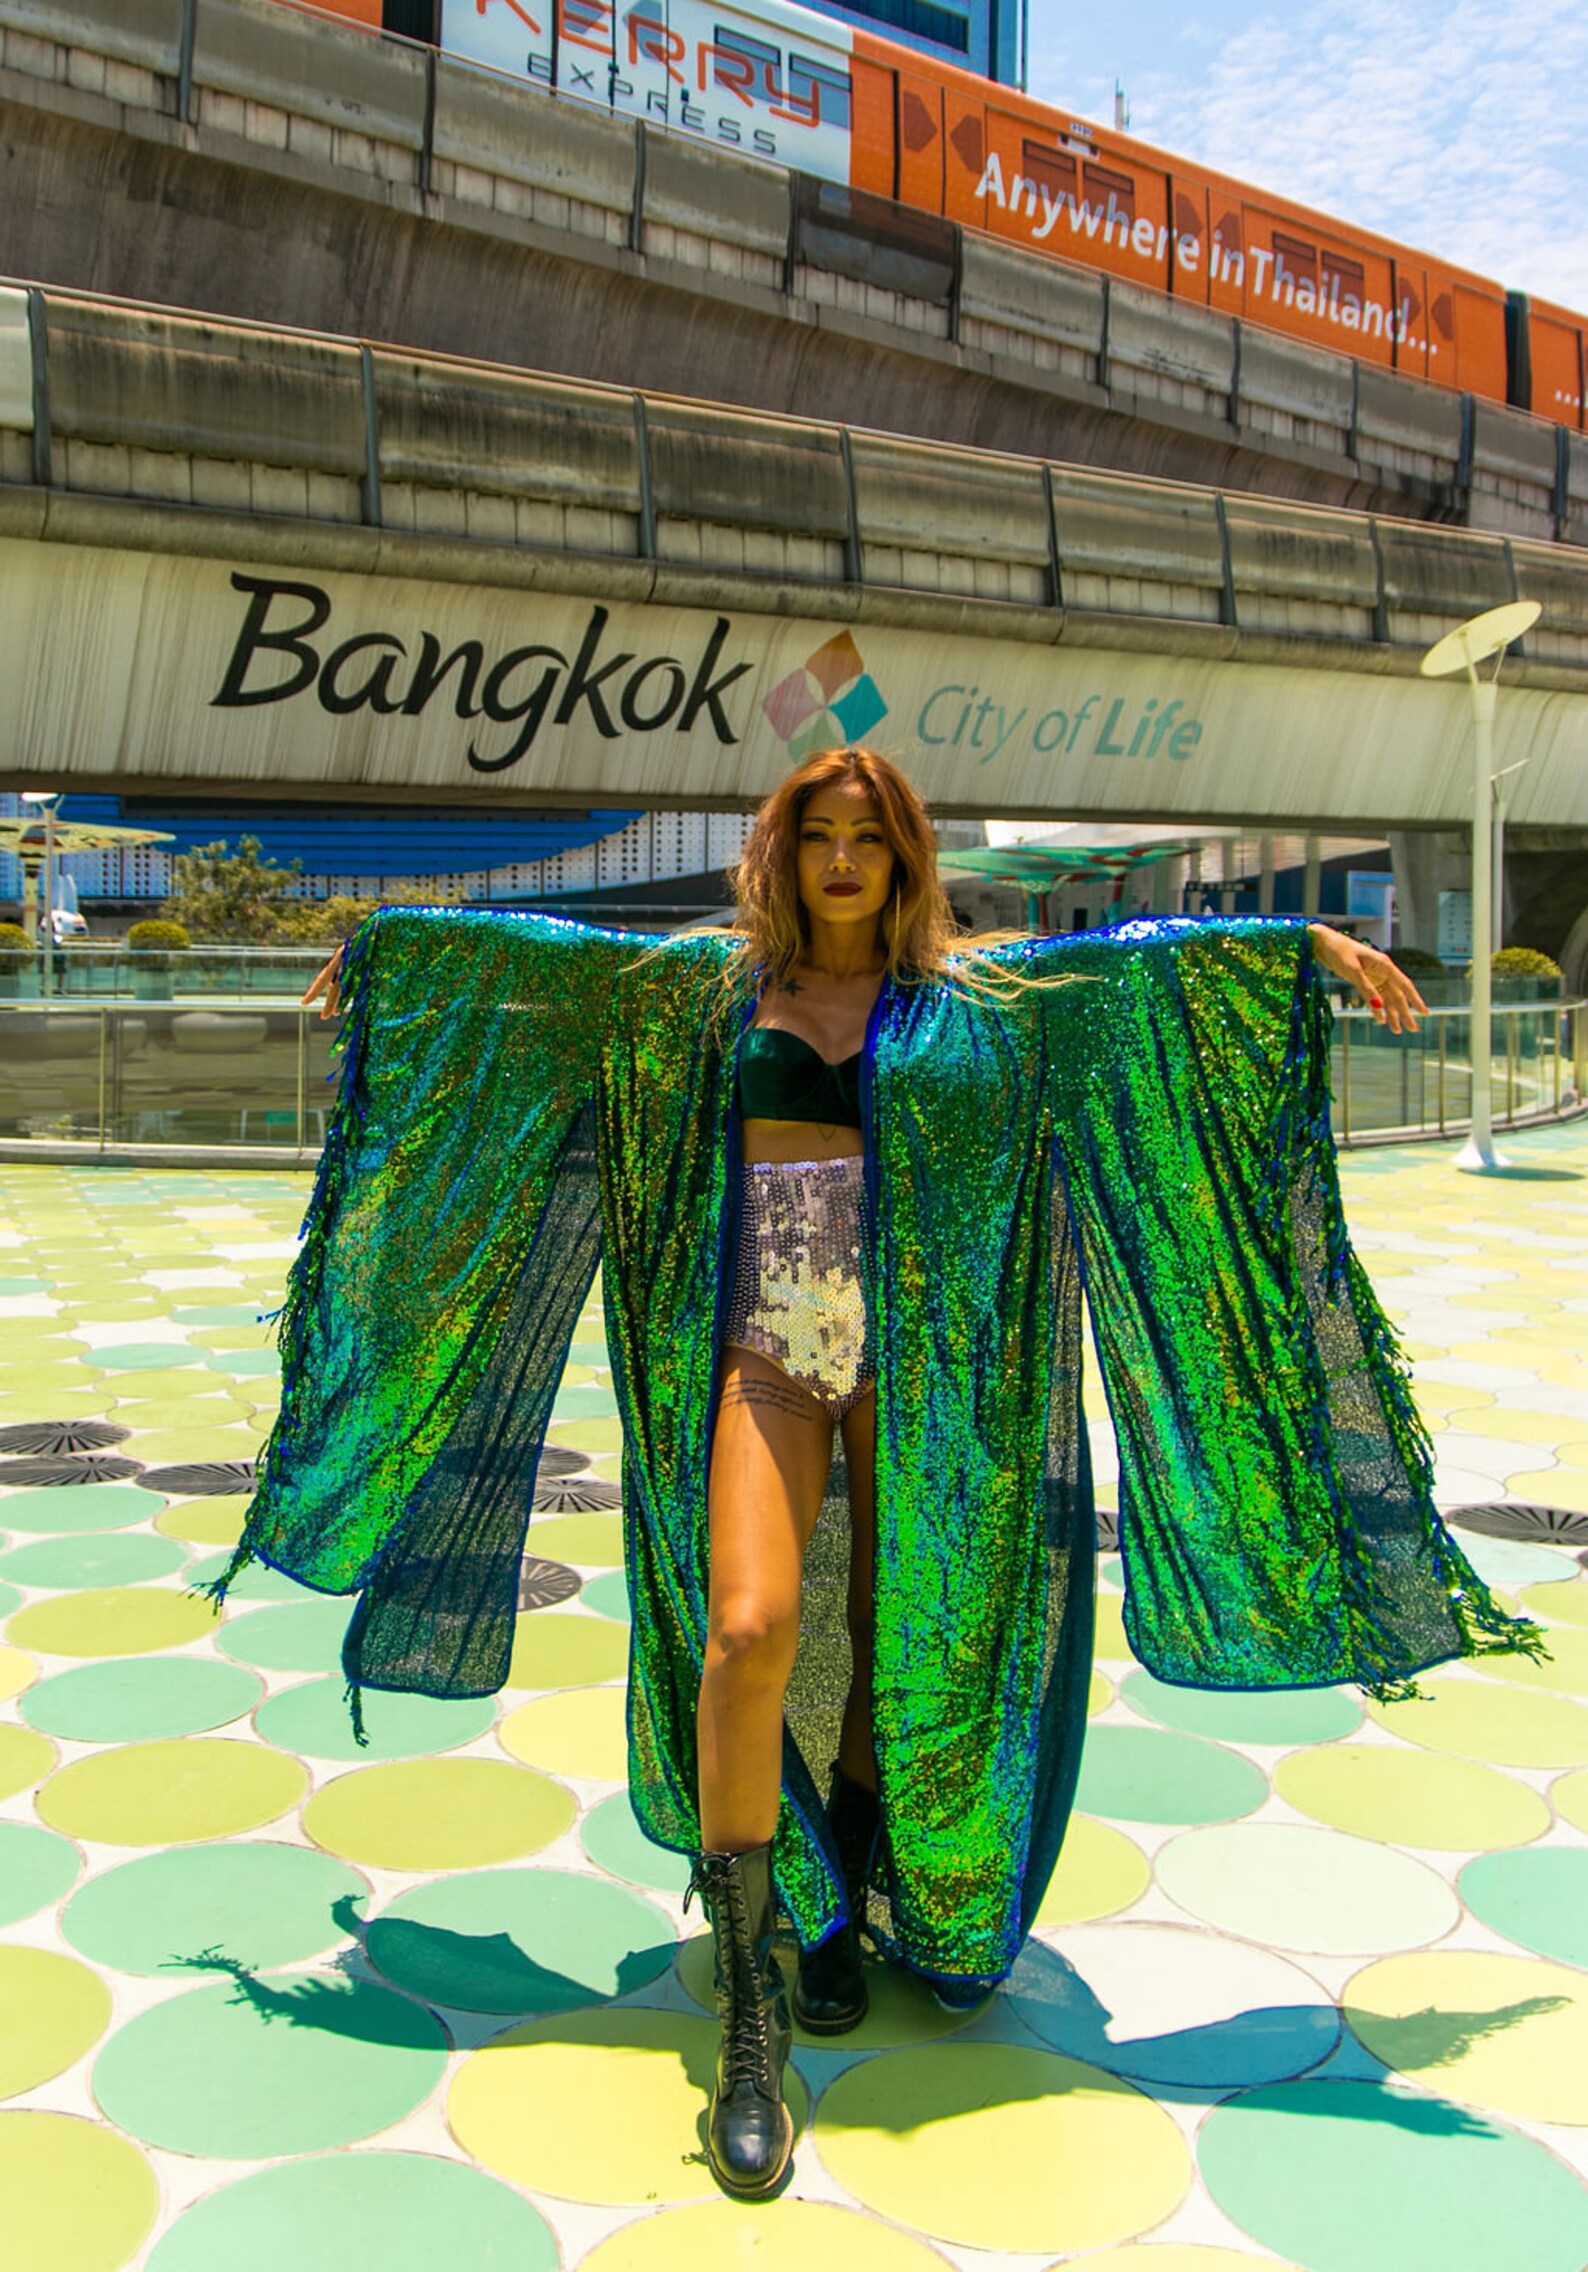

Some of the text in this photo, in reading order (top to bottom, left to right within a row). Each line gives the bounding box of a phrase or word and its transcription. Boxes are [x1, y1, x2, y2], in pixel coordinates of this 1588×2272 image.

[527, 52, 777, 154] EXPRESS
[975, 151, 1201, 271] Anywhere
[208, 570, 755, 773] Bangkok
[917, 684, 1204, 765] City of Life
